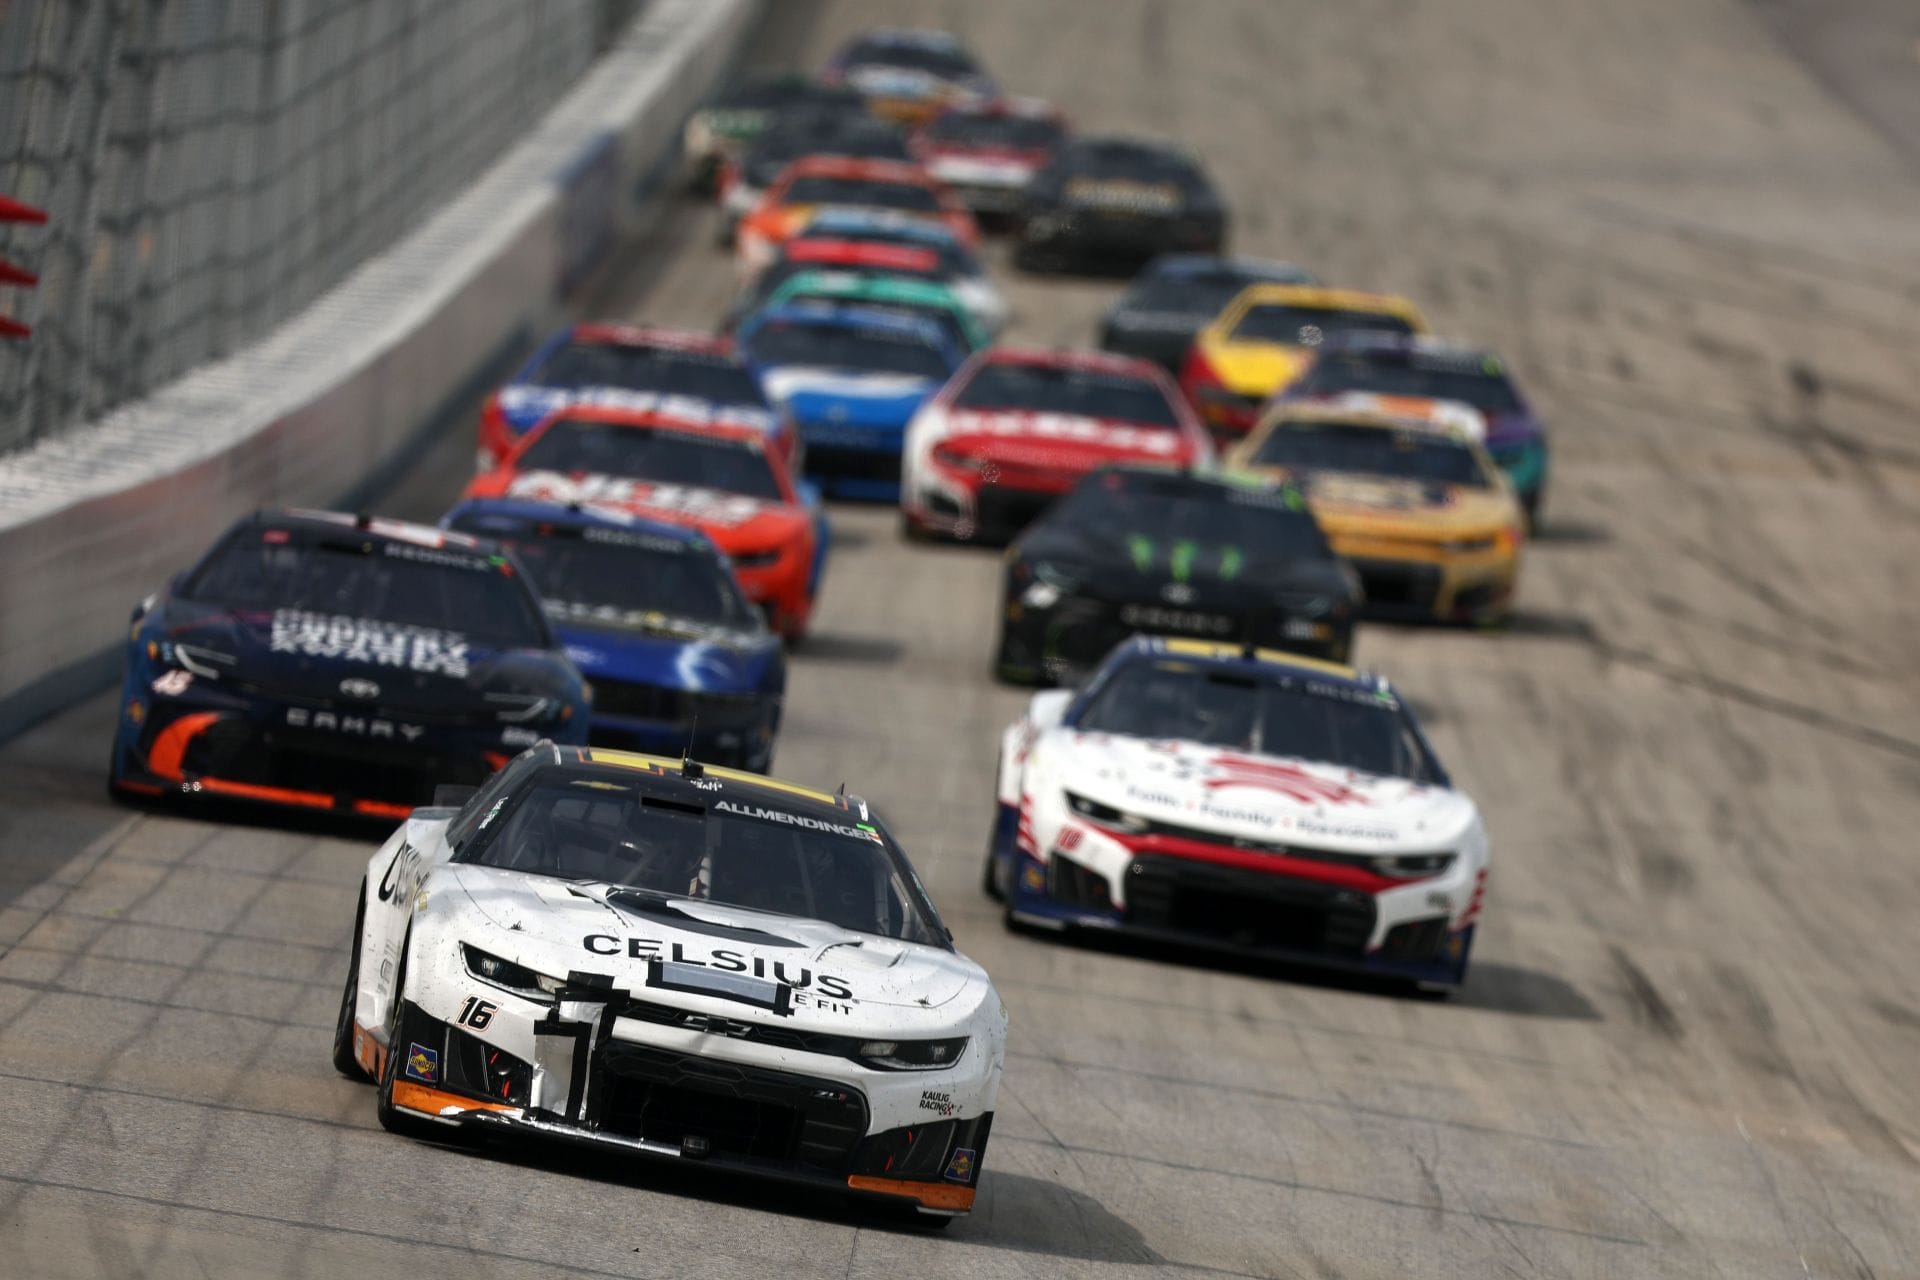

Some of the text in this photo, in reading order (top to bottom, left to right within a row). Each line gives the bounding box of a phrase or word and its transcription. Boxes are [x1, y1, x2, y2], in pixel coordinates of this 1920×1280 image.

[582, 933, 854, 1001] CELSIUS
[456, 994, 501, 1032] 16
[816, 999, 854, 1016] FIT
[921, 1090, 950, 1103] KAULIG
[918, 1100, 948, 1112] RACING
